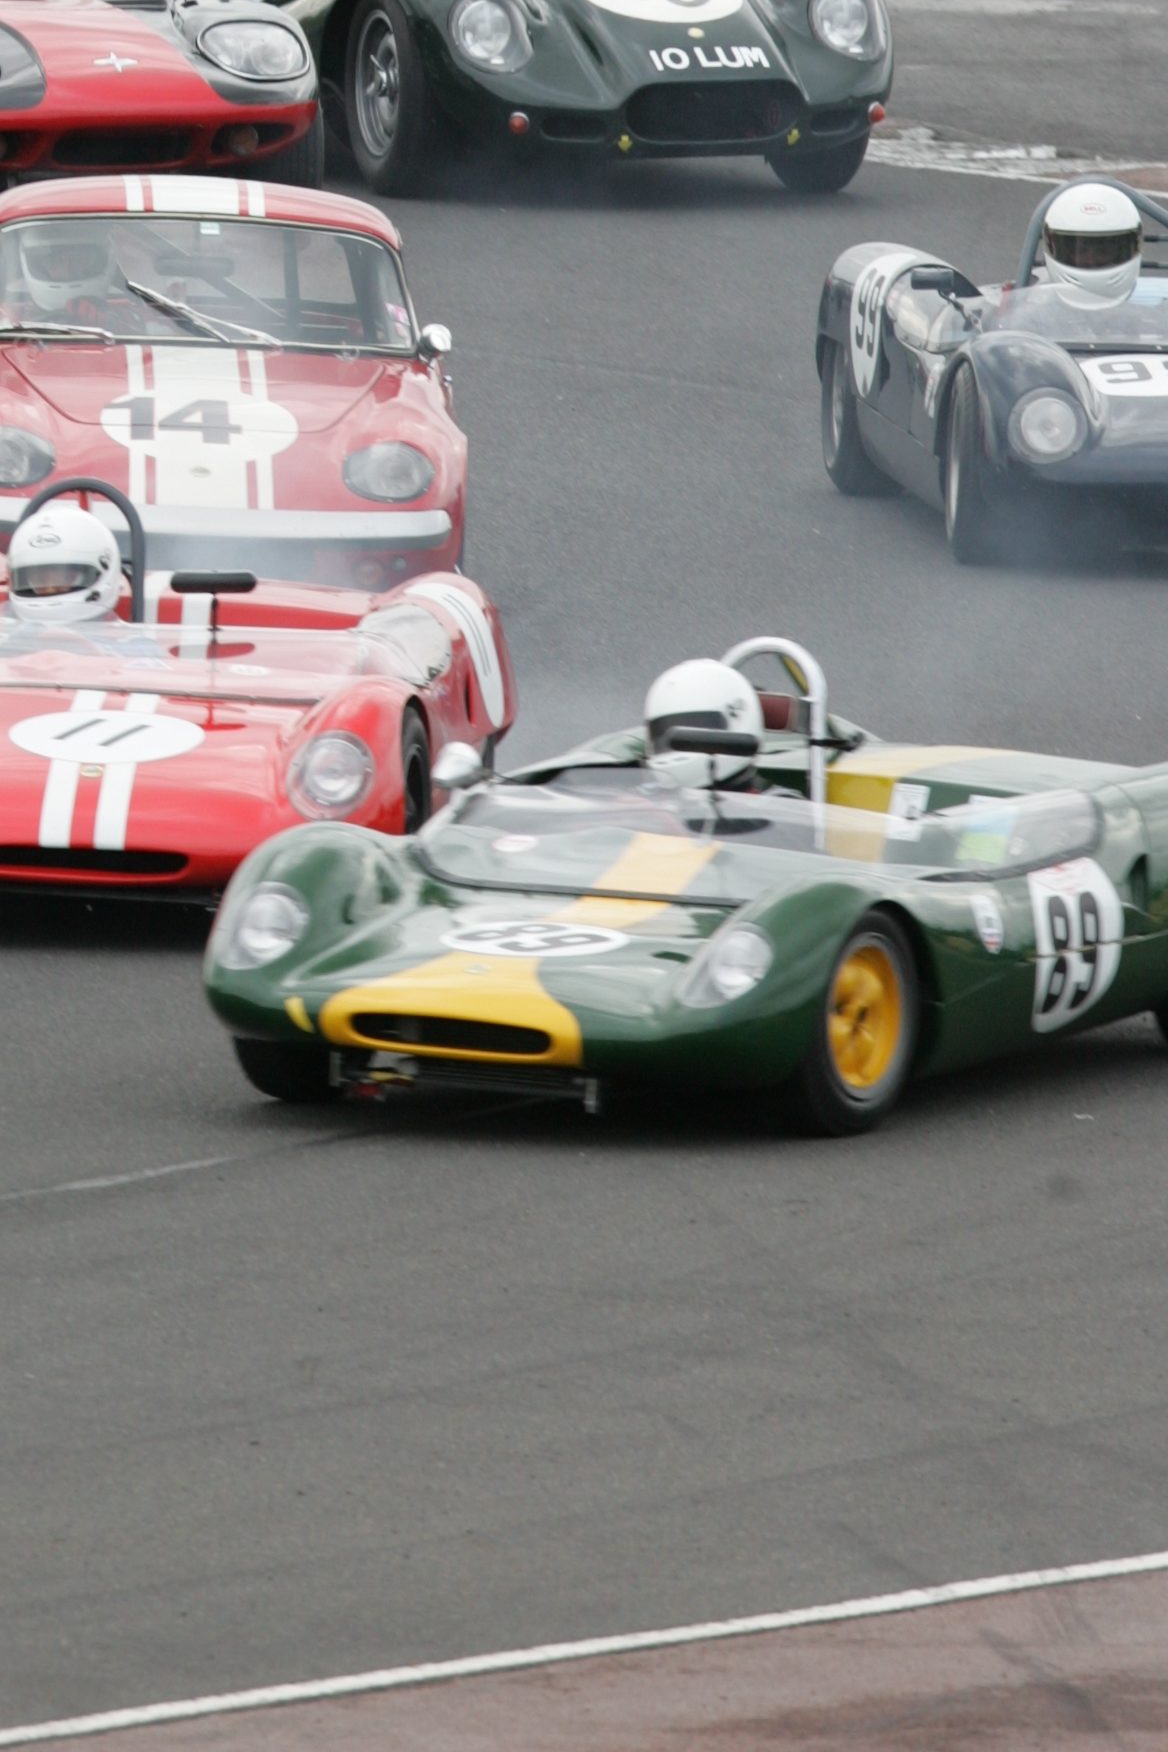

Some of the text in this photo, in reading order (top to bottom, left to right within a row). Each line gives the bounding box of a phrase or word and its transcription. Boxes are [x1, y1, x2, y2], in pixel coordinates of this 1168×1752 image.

[693, 46, 770, 68] LUM
[855, 267, 886, 358] 99
[1098, 360, 1168, 385] 9
[103, 396, 243, 445] 14
[52, 718, 152, 747] 11
[454, 923, 612, 952] 89
[1040, 891, 1100, 1014] 89
